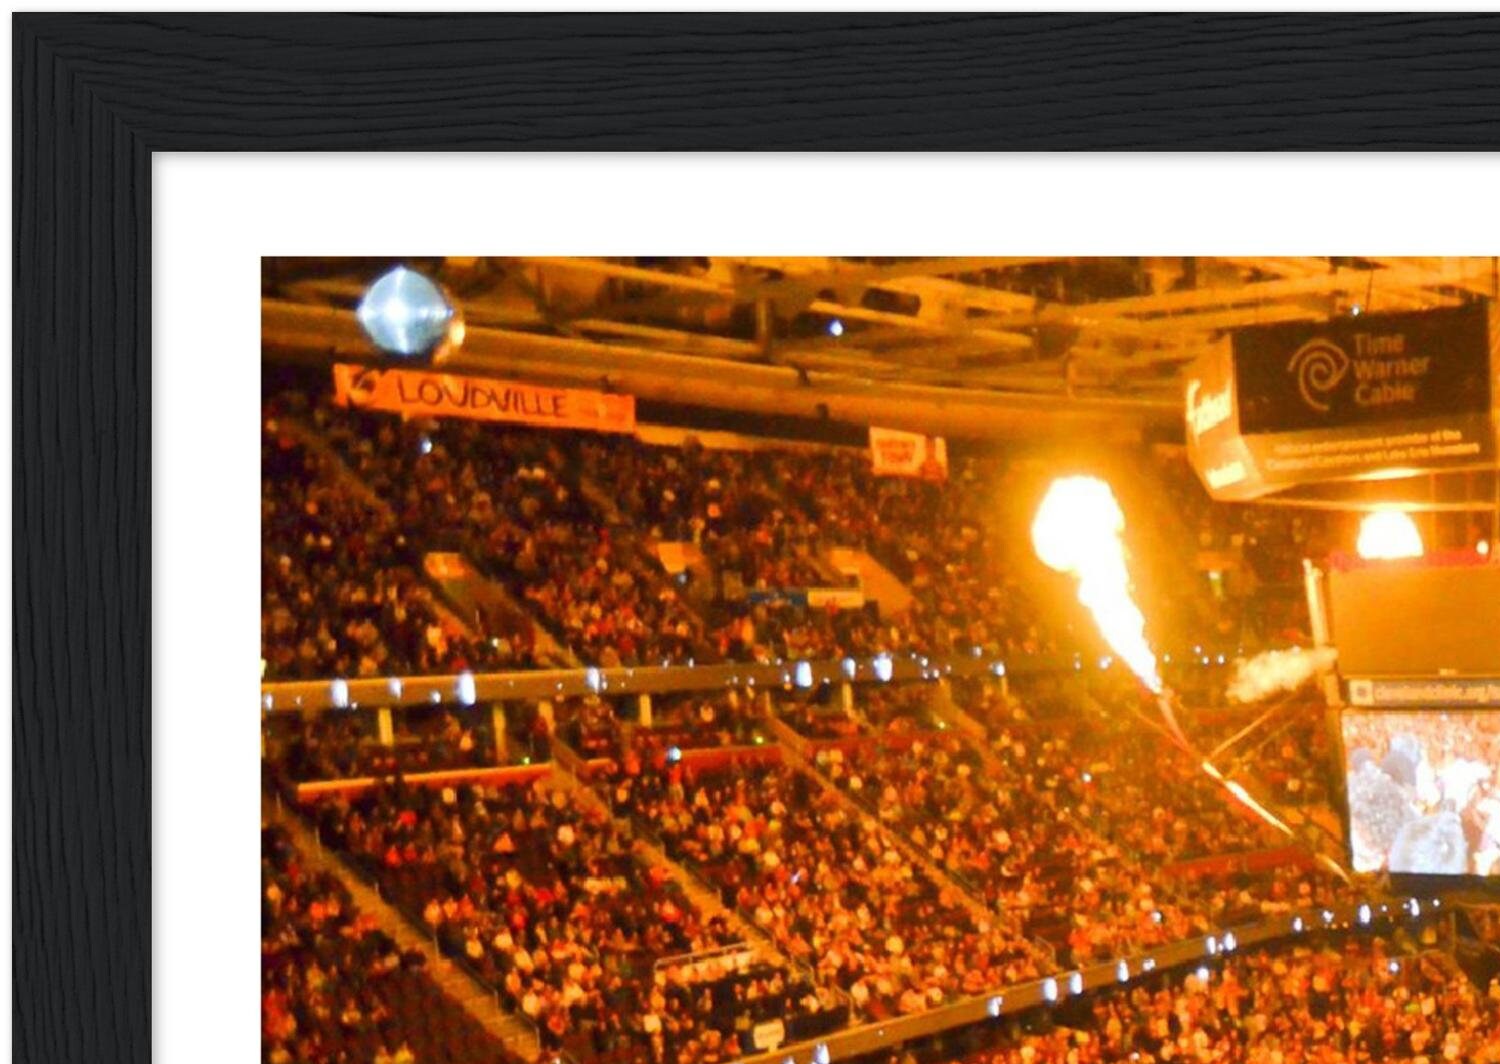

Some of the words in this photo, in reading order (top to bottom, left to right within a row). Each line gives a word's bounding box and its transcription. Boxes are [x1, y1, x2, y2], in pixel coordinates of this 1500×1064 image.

[1353, 333, 1405, 356] Time
[1352, 356, 1431, 380] Warner
[397, 370, 569, 418] LOUDVILLE
[1354, 384, 1418, 406] Cable
